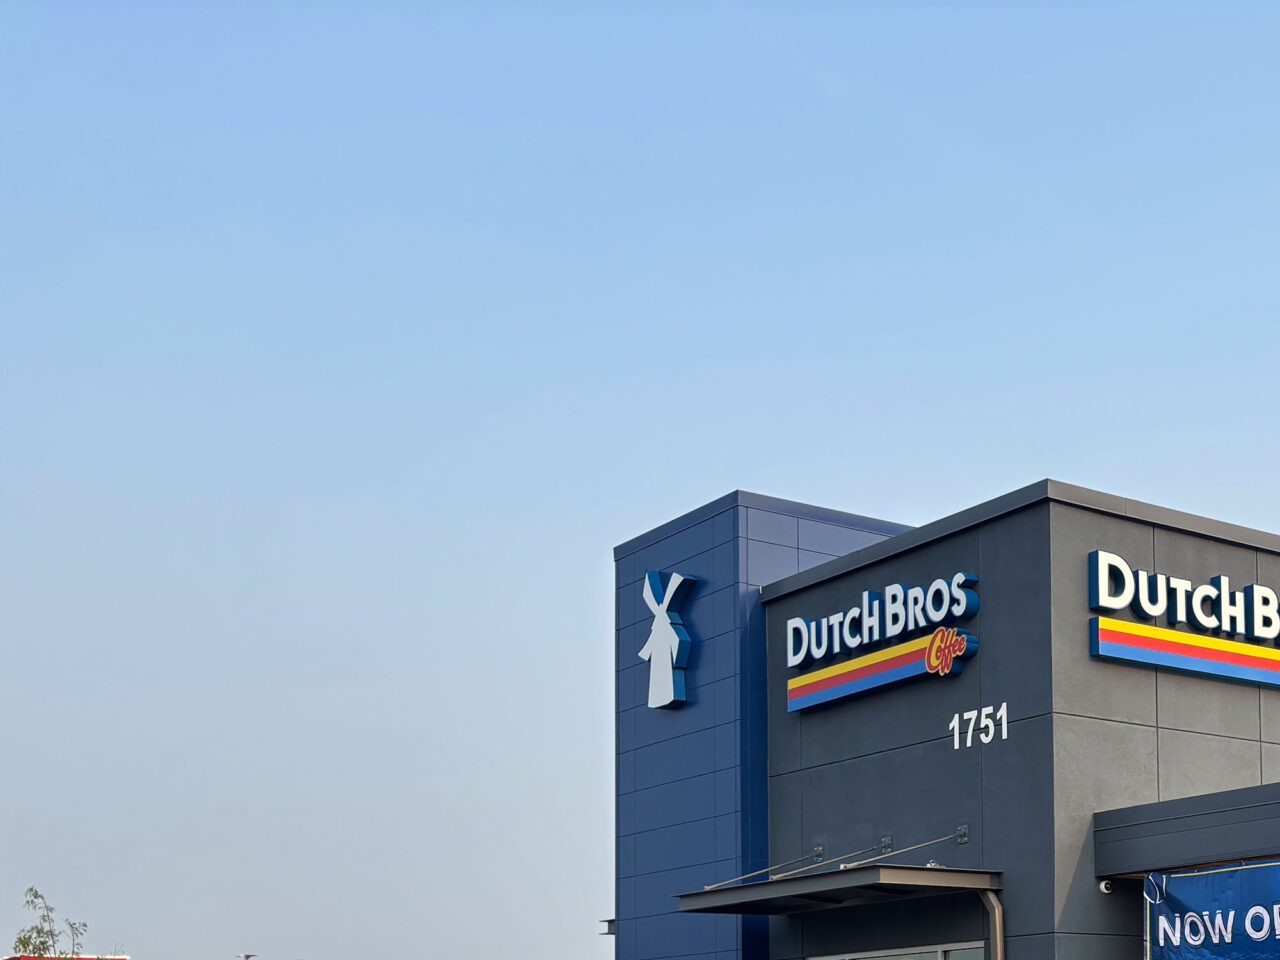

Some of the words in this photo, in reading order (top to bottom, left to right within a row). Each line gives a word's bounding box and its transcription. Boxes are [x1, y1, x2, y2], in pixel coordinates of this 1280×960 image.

[1098, 550, 1246, 636] DUTCH
[786, 590, 880, 668] DUTCH
[885, 572, 967, 638] BROS
[925, 627, 967, 676] Coffee
[949, 702, 1008, 749] 1751
[1158, 910, 1236, 947] NOW
